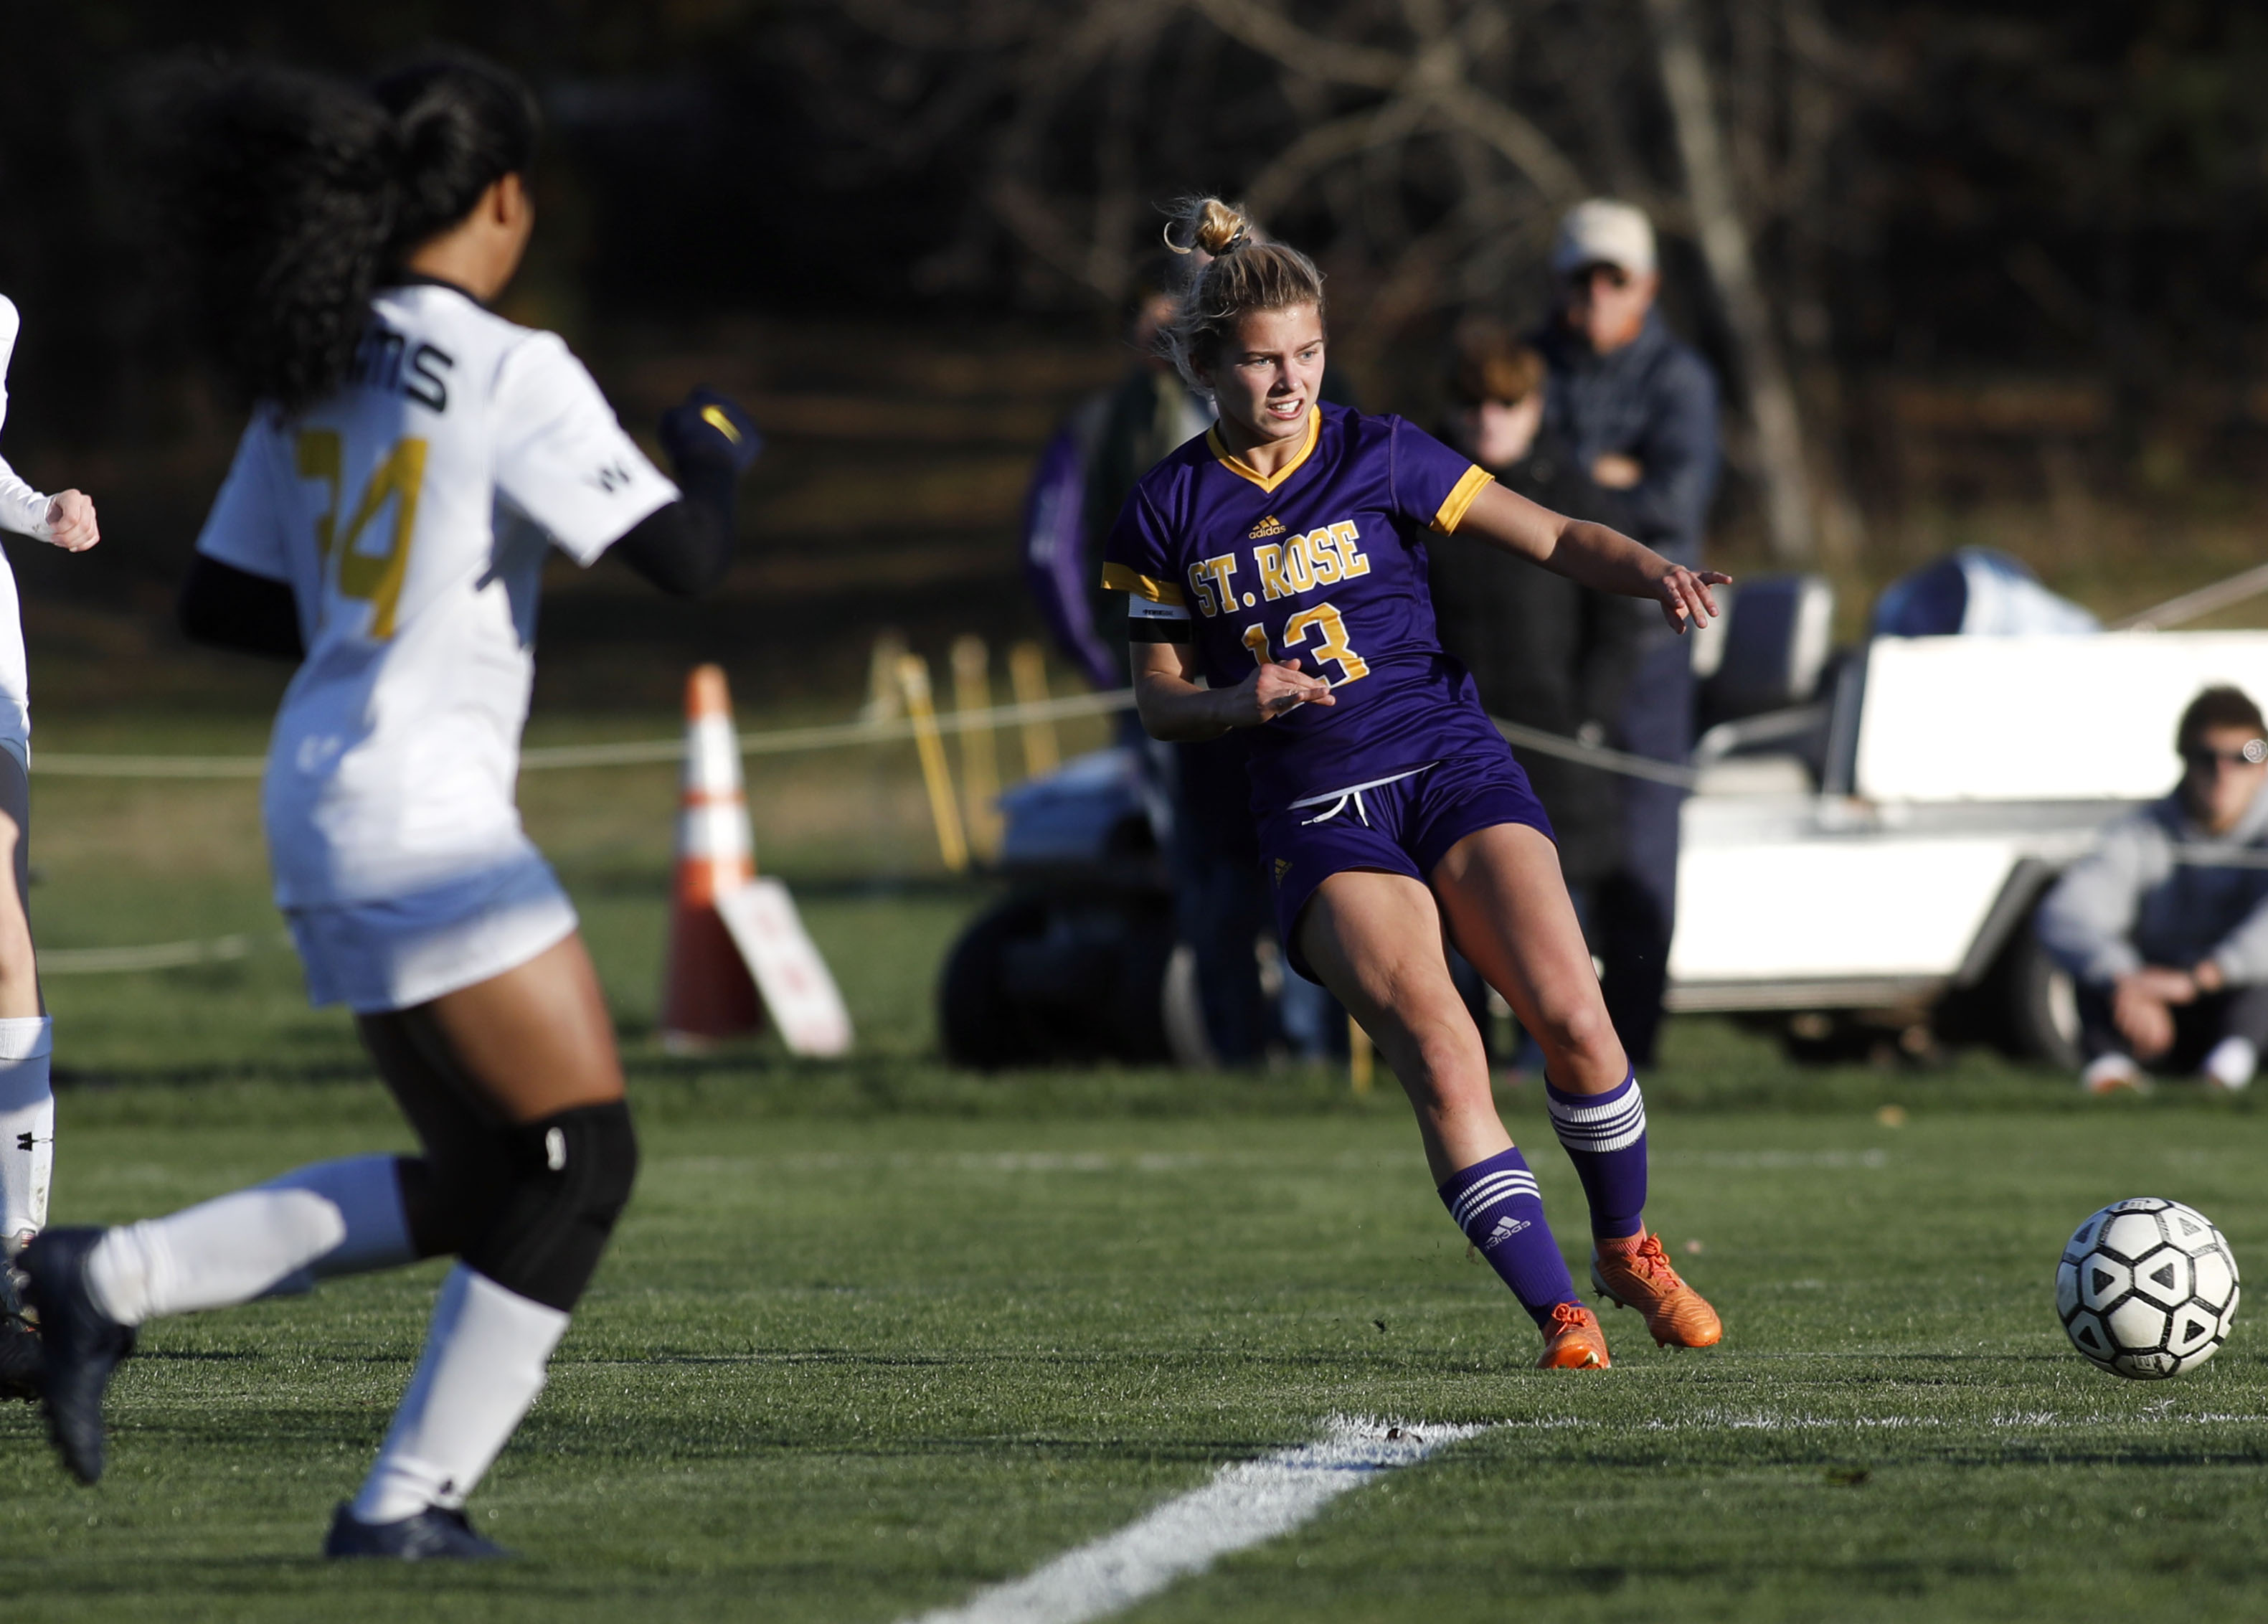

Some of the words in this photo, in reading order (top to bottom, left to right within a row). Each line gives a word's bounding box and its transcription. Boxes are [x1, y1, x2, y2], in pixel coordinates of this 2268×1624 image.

[1188, 552, 1256, 618] ST.
[1253, 519, 1371, 602] ROSE
[1249, 525, 1287, 539] adidas
[1241, 602, 1369, 717] 13
